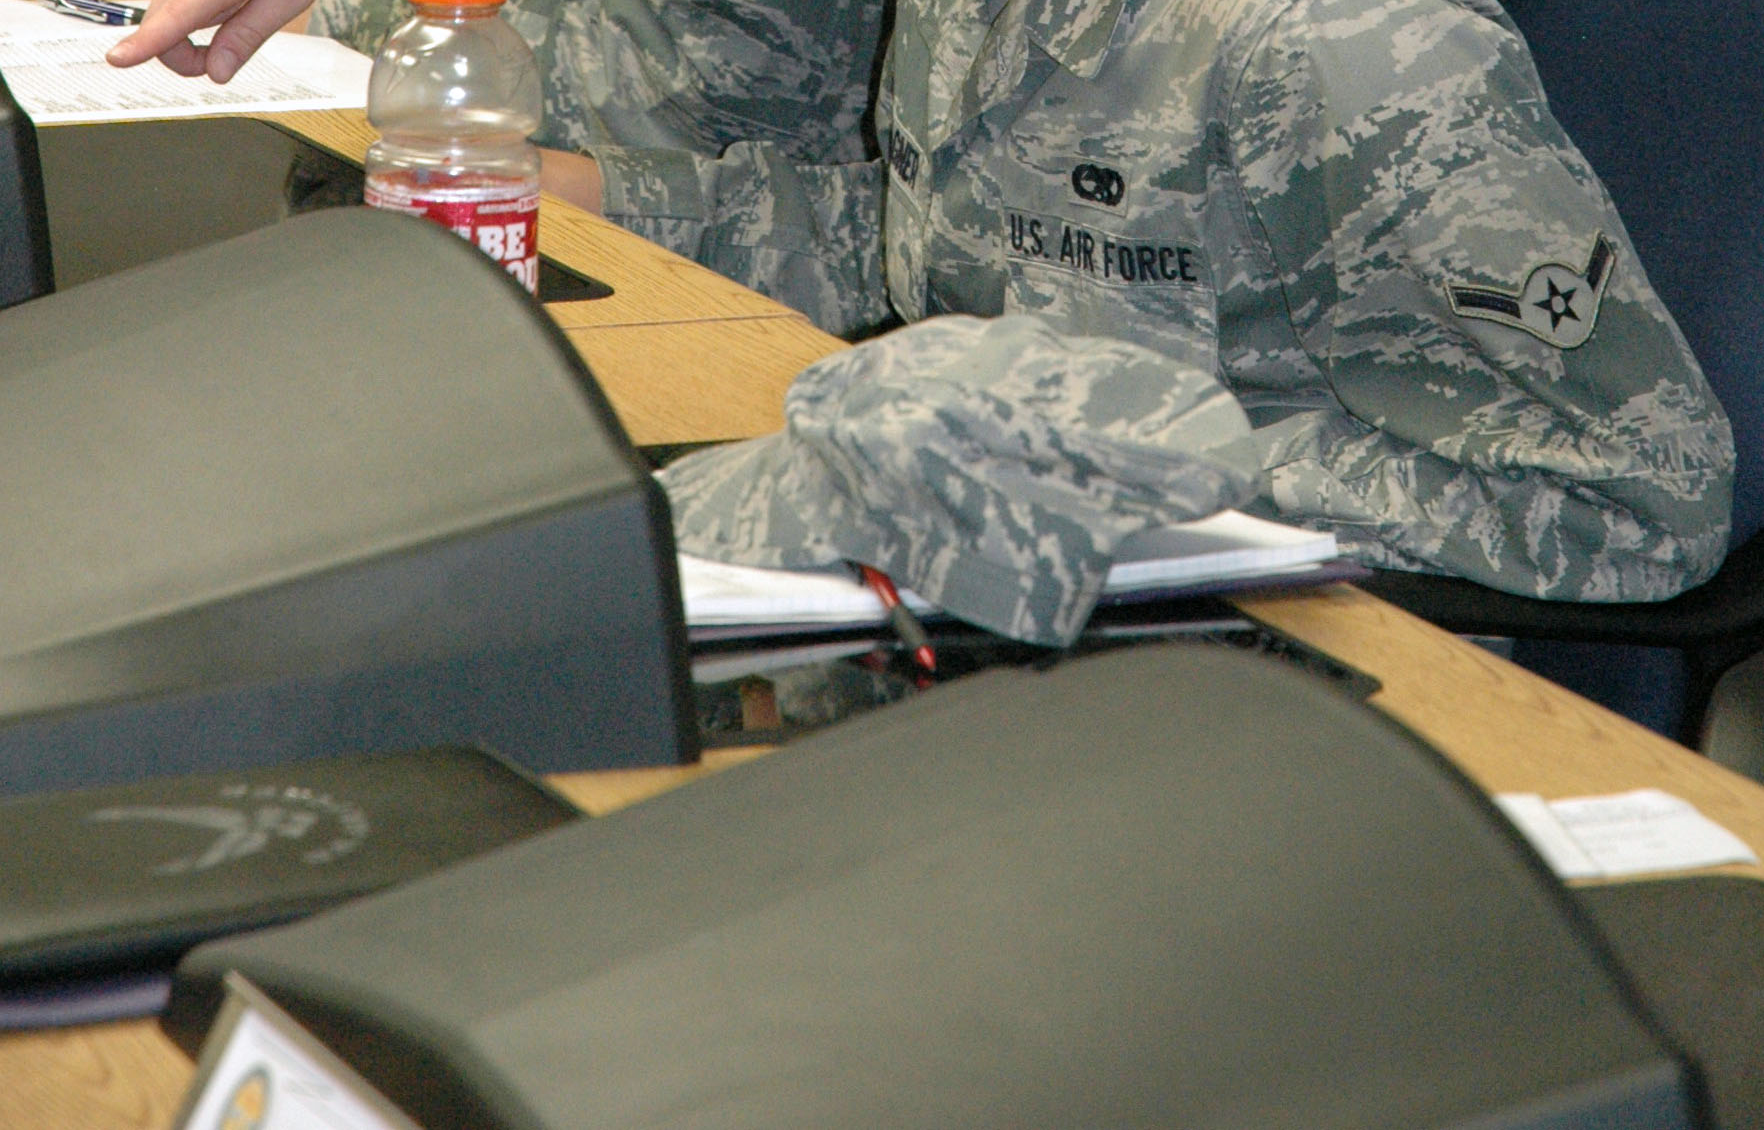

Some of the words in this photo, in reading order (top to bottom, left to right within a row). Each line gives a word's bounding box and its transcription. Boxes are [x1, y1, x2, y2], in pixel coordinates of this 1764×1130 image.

[1010, 213, 1050, 258] U.S.
[1060, 226, 1095, 272] AIR
[1103, 241, 1197, 282] FORCE
